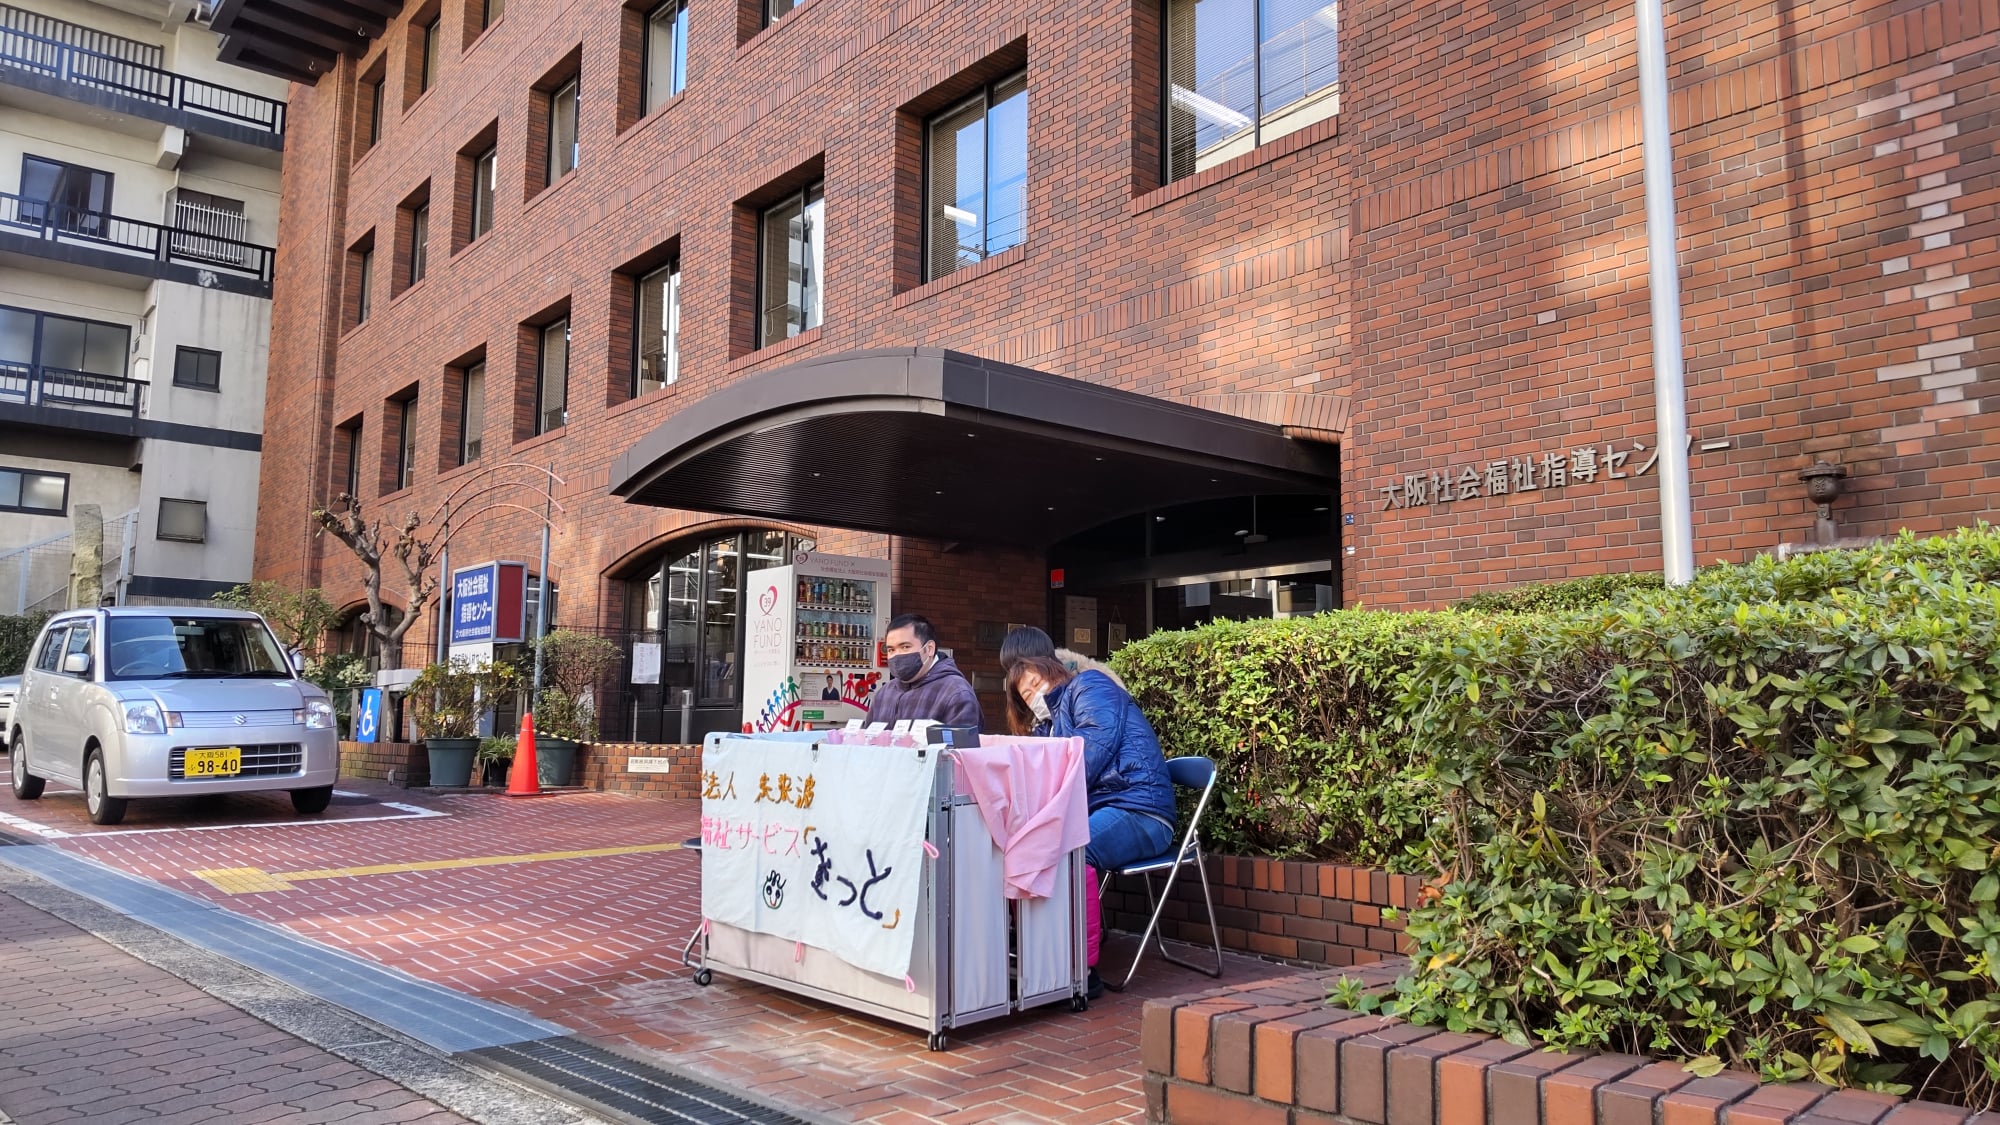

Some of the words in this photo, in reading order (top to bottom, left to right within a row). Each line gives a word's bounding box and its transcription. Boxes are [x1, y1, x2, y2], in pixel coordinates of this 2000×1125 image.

[1380, 434, 1730, 511] 大阪社会福祉指導センー
[198, 759, 238, 773] 98-40
